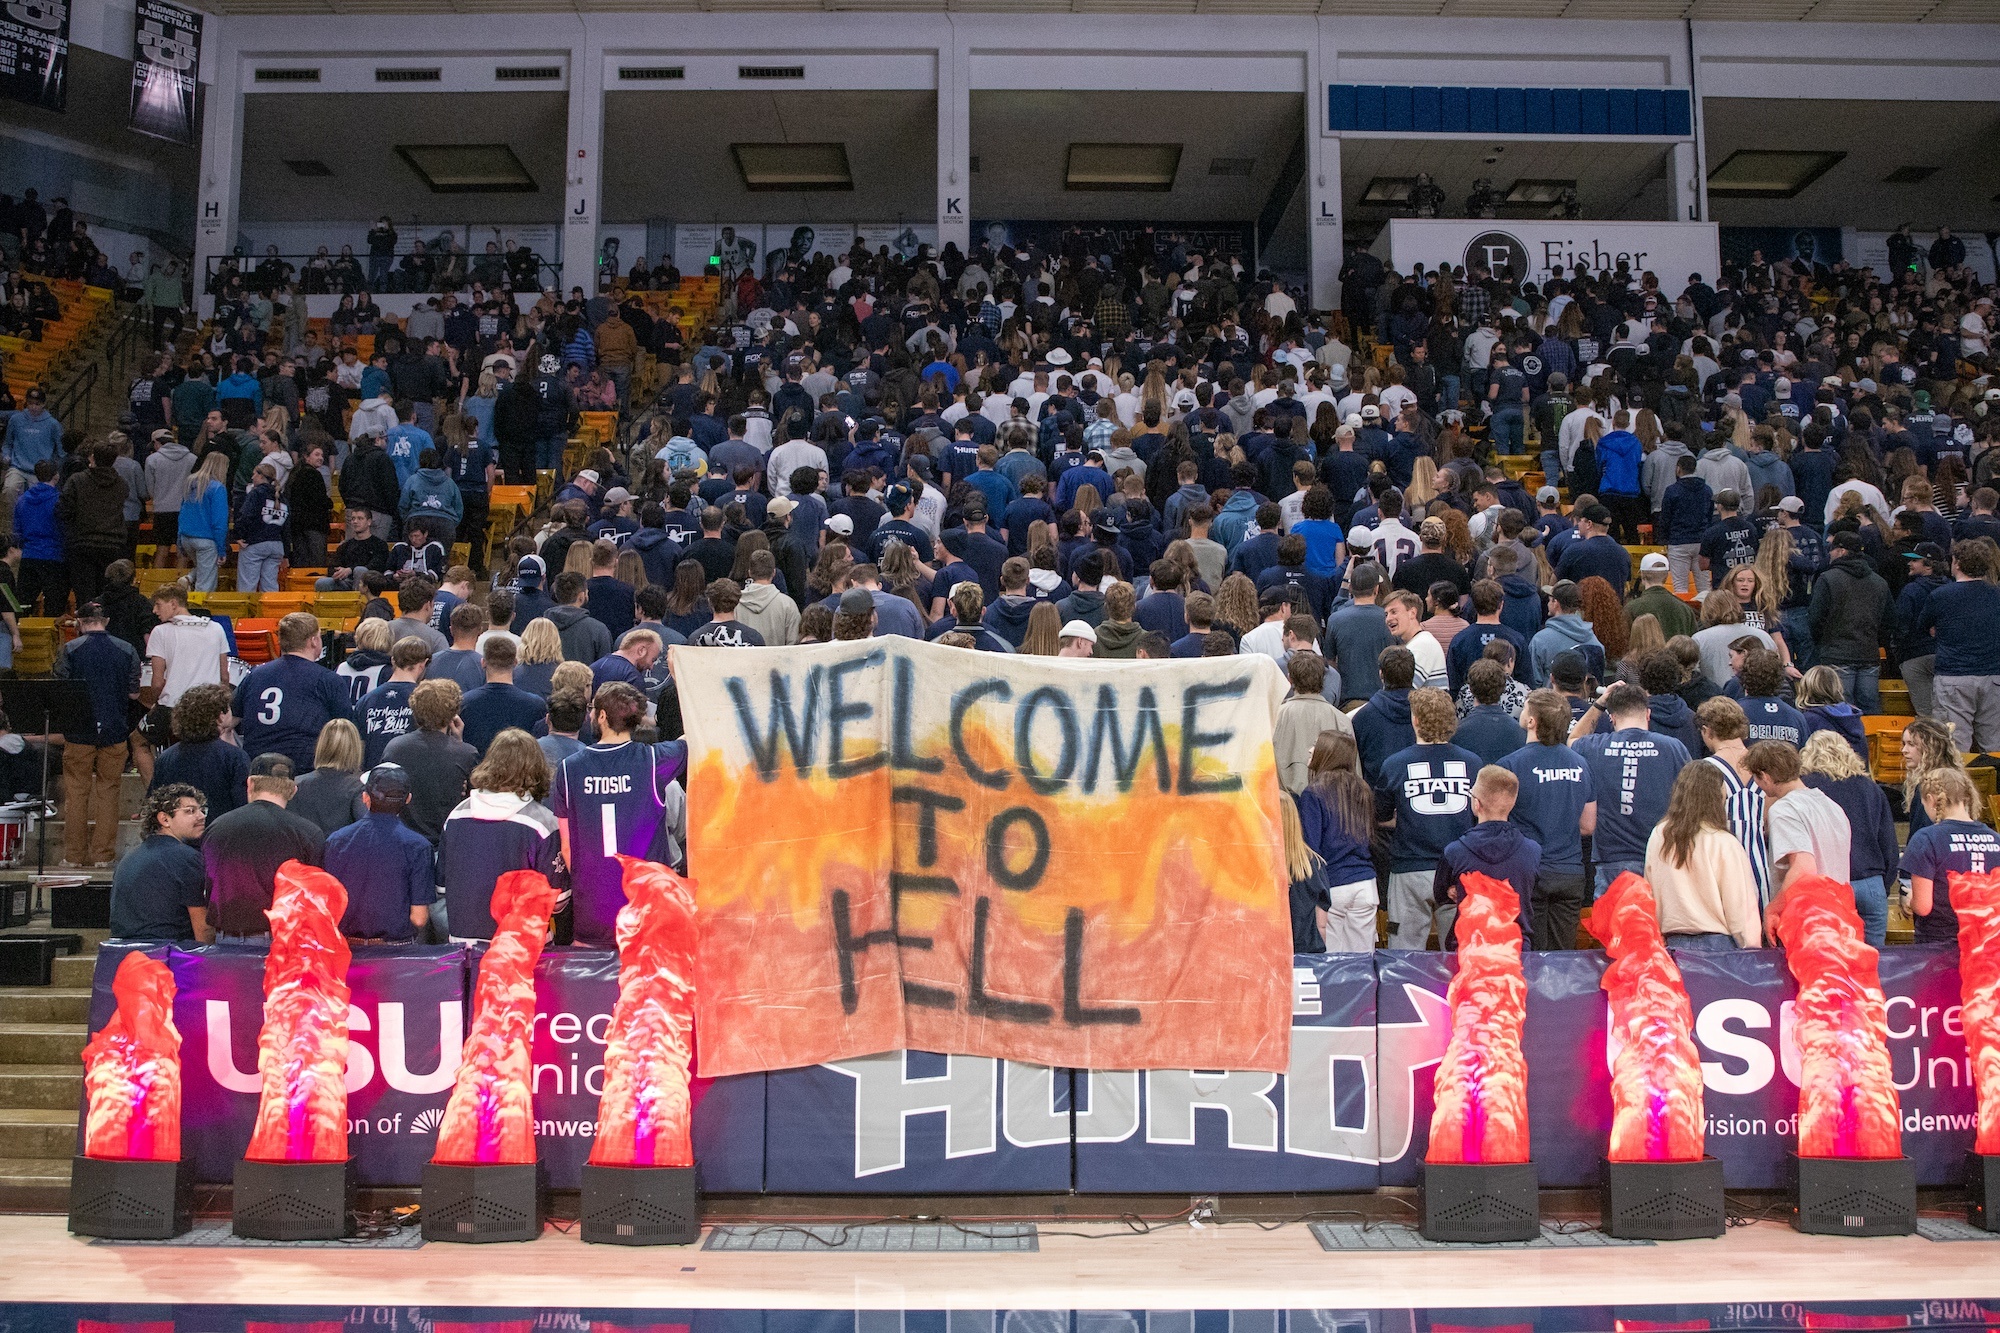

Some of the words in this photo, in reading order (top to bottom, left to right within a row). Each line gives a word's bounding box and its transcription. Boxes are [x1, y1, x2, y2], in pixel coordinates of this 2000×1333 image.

[138, 6, 200, 33] BASKETBALL
[147, 2, 193, 22] WOMEN'S
[0, 28, 68, 55] APPEARANES
[22, 62, 31, 71] 12
[205, 202, 219, 217] H
[574, 199, 585, 215] J
[947, 198, 962, 214] K
[1322, 201, 1334, 217] L
[1541, 239, 1648, 271] Fisher
[1725, 529, 1750, 540] LIGHT
[1374, 538, 1416, 575] 12
[257, 686, 284, 726] 3
[384, 716, 410, 731] BULL
[722, 648, 1252, 797] WELCOME
[1621, 749, 1659, 757] PROUD
[1625, 741, 1655, 749] LOUD
[1623, 757, 1638, 765] BE
[584, 774, 632, 795] STOSIC
[1533, 766, 1583, 784] HURD
[1404, 778, 1474, 799] STATE
[601, 803, 618, 858] 1
[892, 786, 1051, 892] TO
[1950, 834, 1966, 843] BE
[1966, 834, 1995, 843] LOUD
[1949, 843, 1965, 852] BE
[1965, 843, 2000, 852] PROUD
[1971, 852, 1985, 861] BE
[830, 872, 1142, 1027] HELL
[1884, 995, 1965, 1040] Cre
[1890, 1054, 1974, 1091] Uni
[377, 1112, 403, 1135] of
[1700, 1112, 1767, 1136] vision
[1775, 1111, 1799, 1135] of
